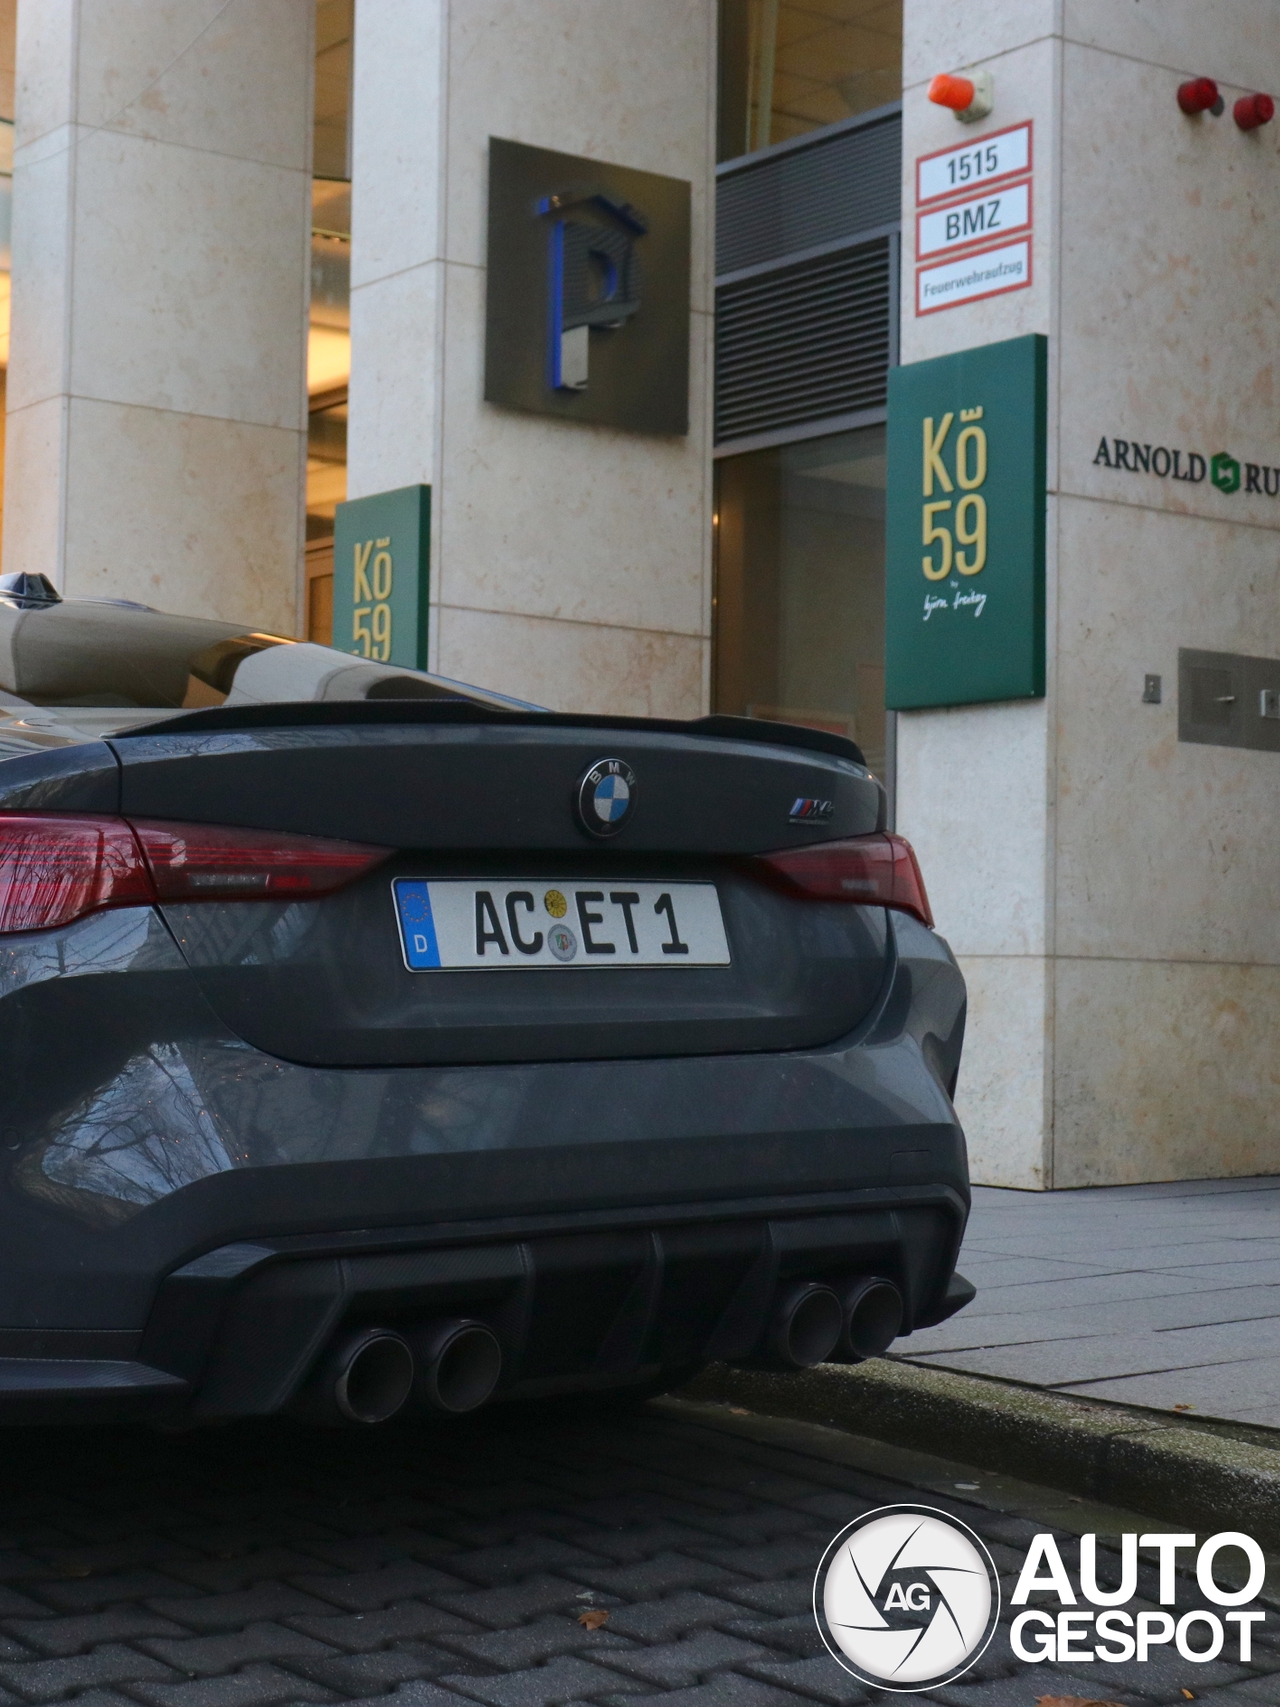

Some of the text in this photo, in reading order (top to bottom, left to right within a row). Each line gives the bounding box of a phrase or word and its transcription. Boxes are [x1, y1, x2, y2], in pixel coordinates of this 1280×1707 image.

[947, 145, 998, 184] 1515
[945, 199, 1002, 241] BMZ
[923, 260, 1023, 297] Feuerwehraufzug
[1092, 436, 1207, 483] ARNOLD
[922, 493, 987, 581] 59
[352, 602, 392, 662] 59
[588, 761, 636, 787] BMW
[413, 934, 428, 953] D
[474, 890, 544, 955] AC
